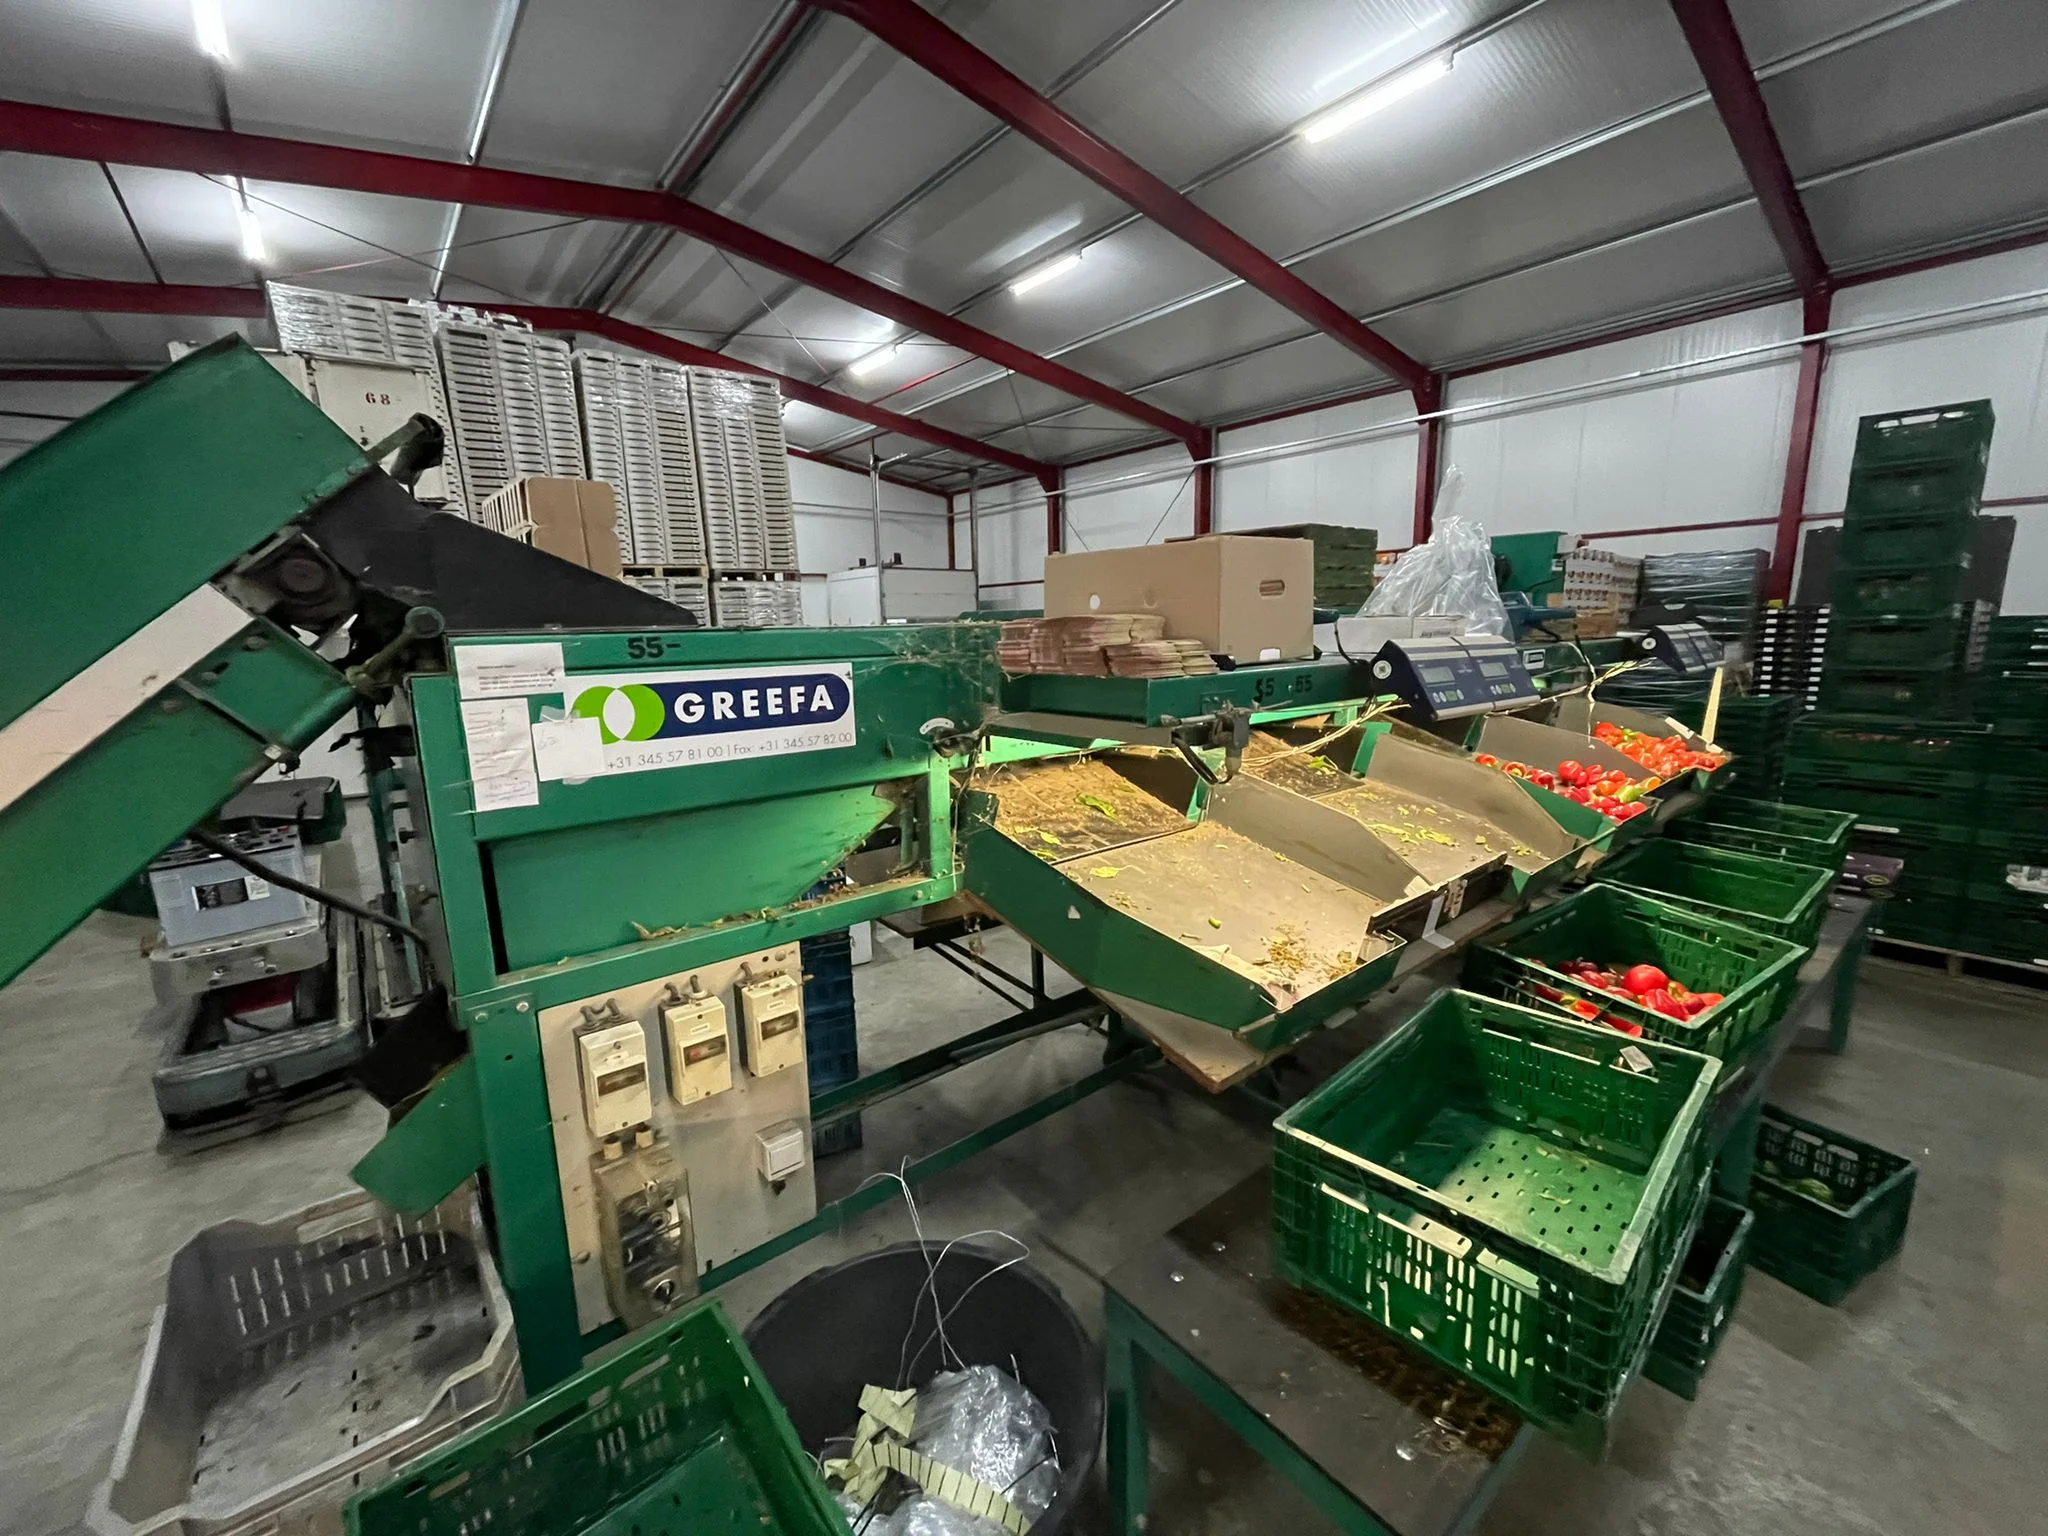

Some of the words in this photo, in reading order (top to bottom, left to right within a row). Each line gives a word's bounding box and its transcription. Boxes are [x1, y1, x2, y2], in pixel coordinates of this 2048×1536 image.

[674, 684, 835, 724] GREEFA
[607, 756, 632, 769] +31
[638, 752, 663, 766] 345
[667, 750, 683, 763] 57
[687, 748, 702, 761] 81
[707, 746, 723, 758] 00
[759, 740, 778, 752] +31
[783, 736, 804, 749] 345
[808, 735, 820, 746] 57
[823, 734, 837, 745] 82
[838, 732, 852, 743] 00
